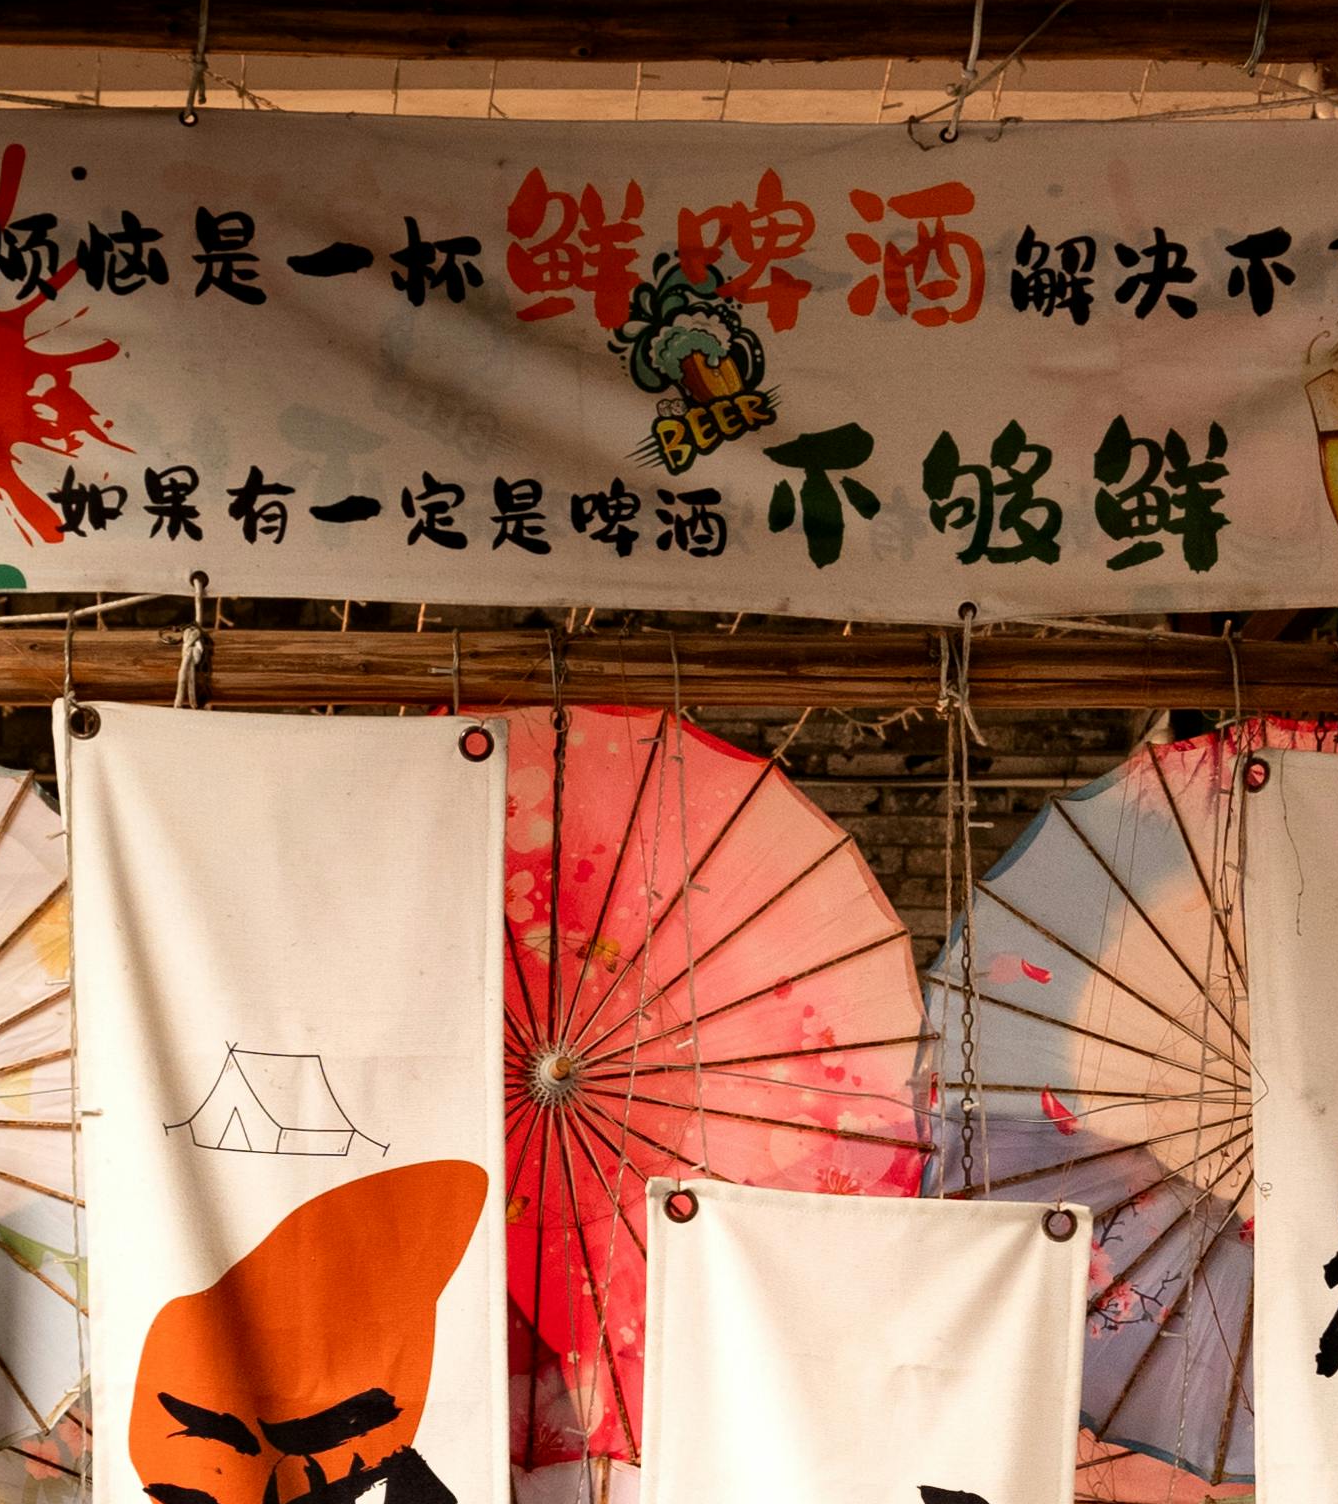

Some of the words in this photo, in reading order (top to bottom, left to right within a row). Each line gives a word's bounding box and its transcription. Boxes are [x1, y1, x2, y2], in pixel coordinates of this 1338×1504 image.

[654, 393, 773, 473] BEER
[55, 414, 1231, 573] 如果有一定是啤酒不够鲜
